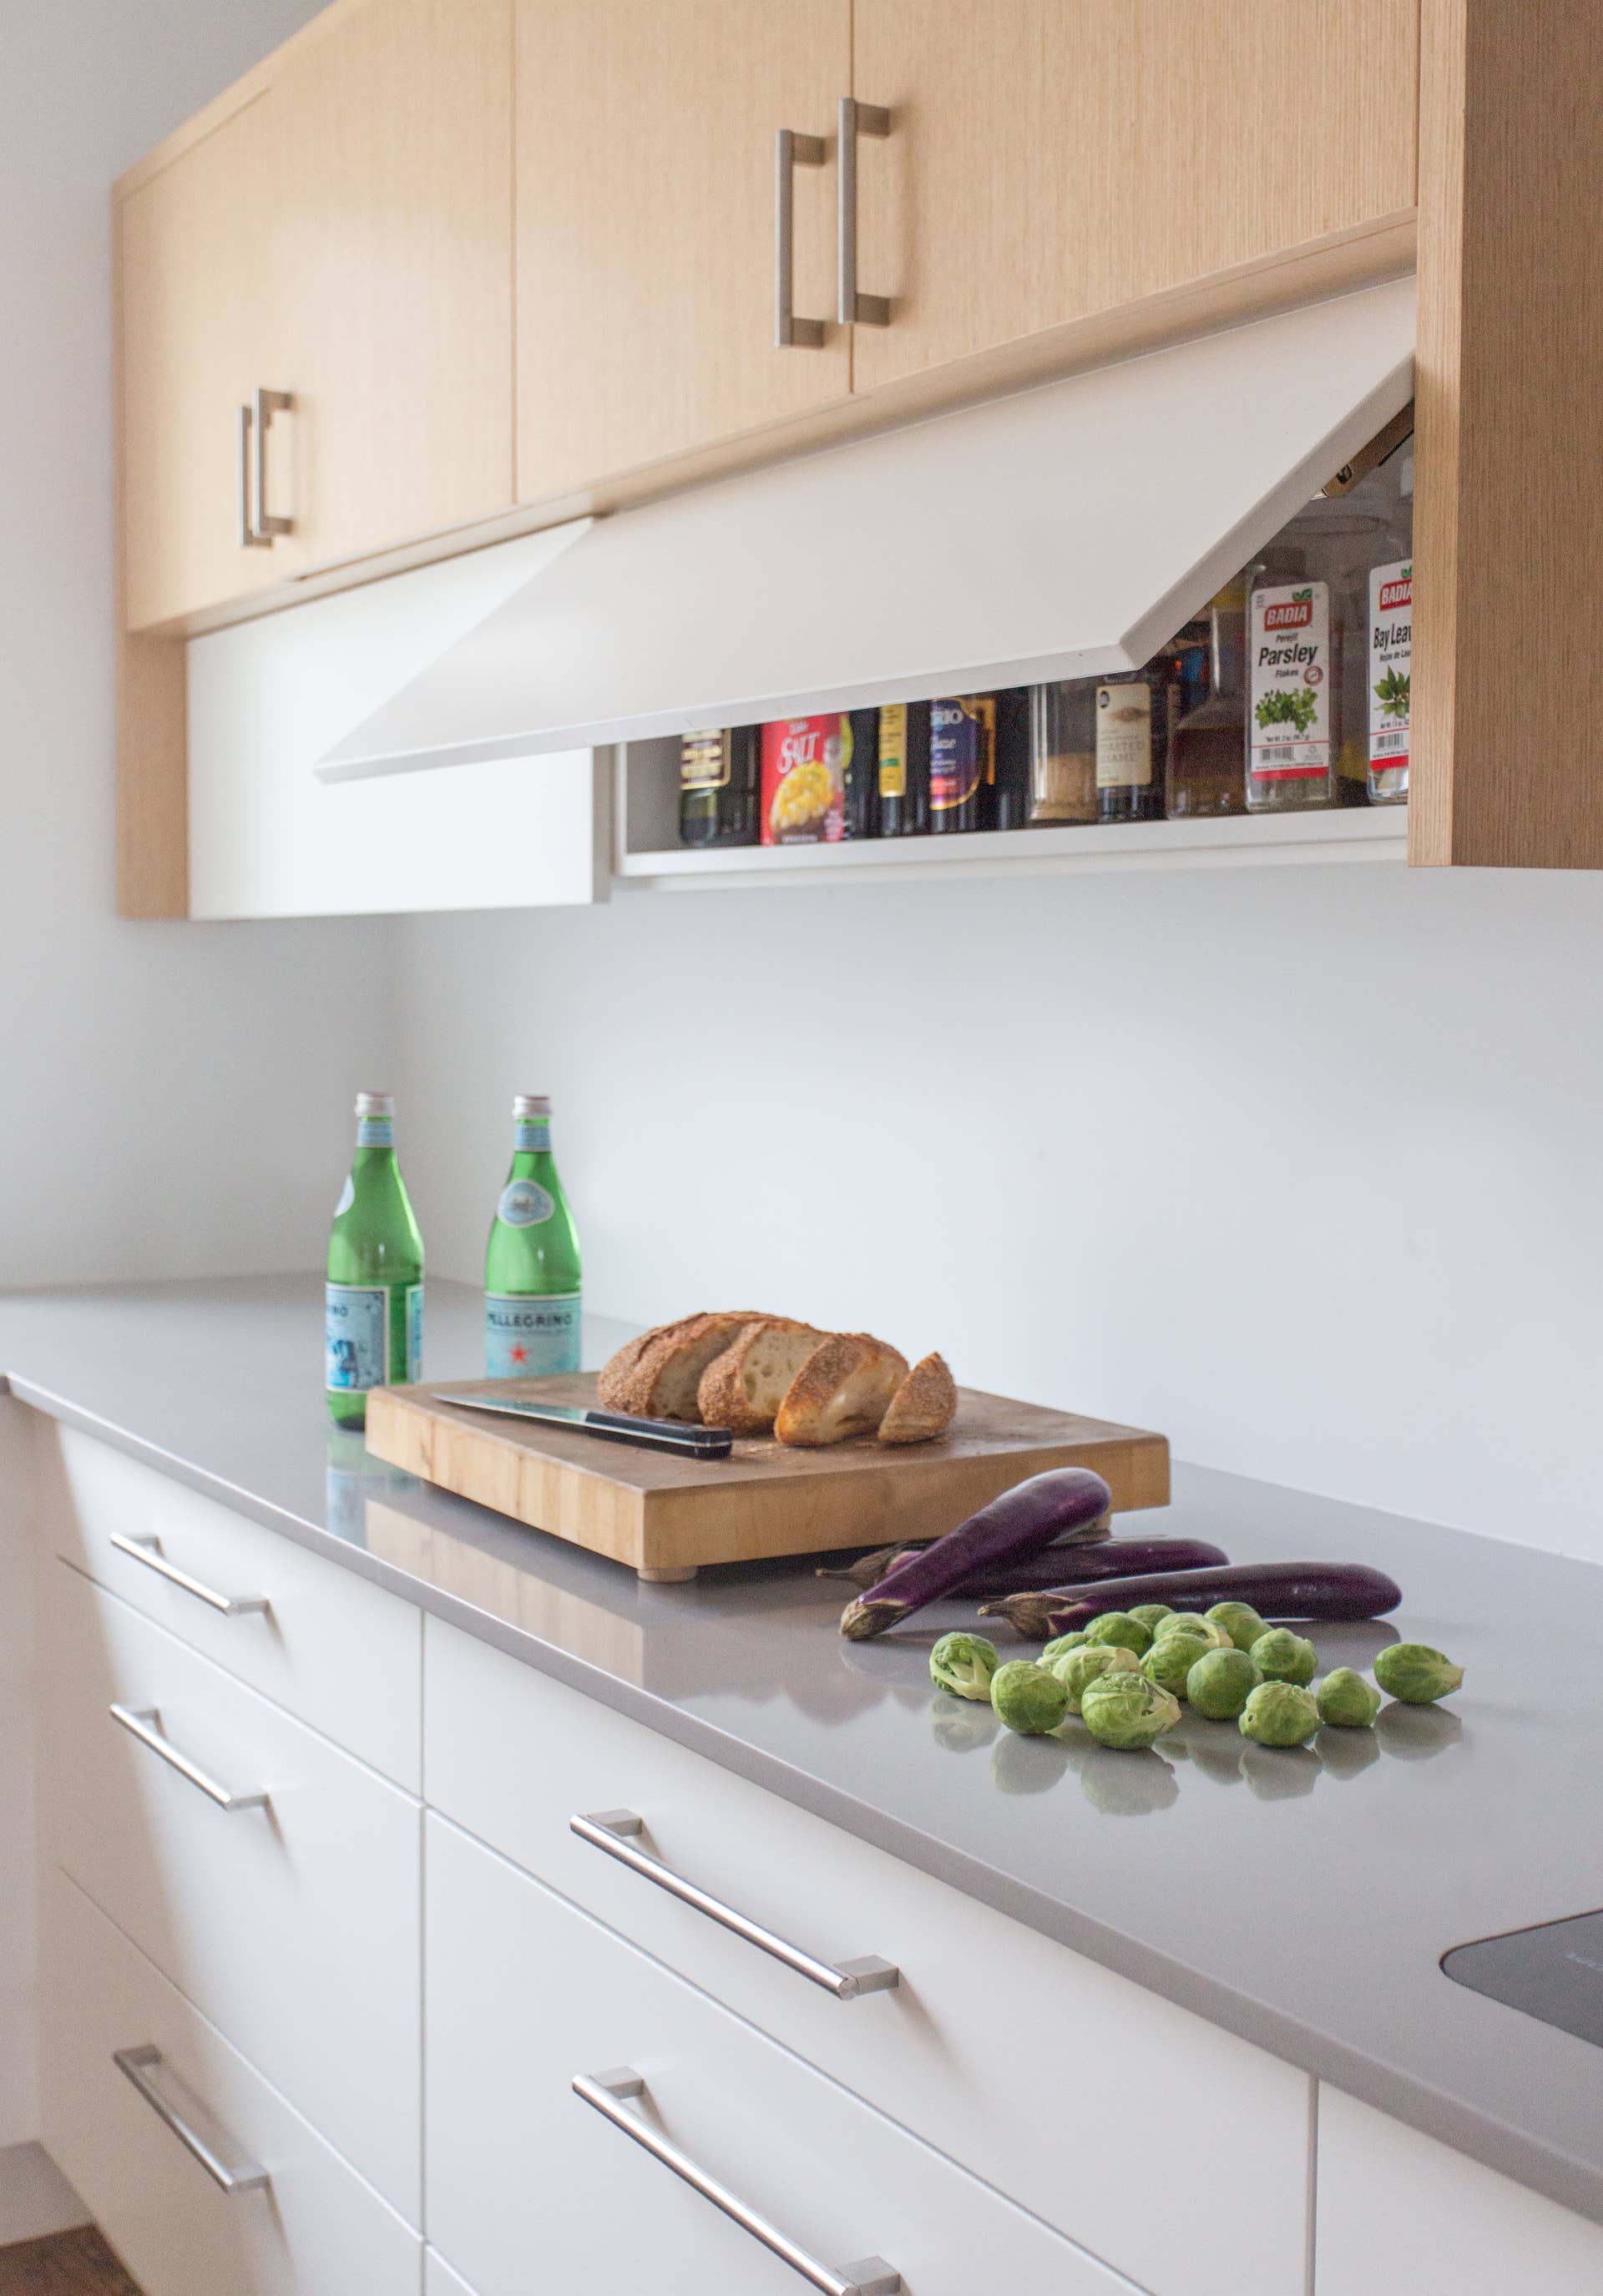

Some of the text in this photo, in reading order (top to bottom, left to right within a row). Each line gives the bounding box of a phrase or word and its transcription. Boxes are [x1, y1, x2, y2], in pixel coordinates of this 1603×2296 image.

[1383, 583, 1412, 604] BADIA
[1267, 605, 1308, 625] BADIA
[1373, 627, 1389, 651] Bay
[1258, 643, 1318, 666] Parsley
[776, 731, 822, 775] SALT
